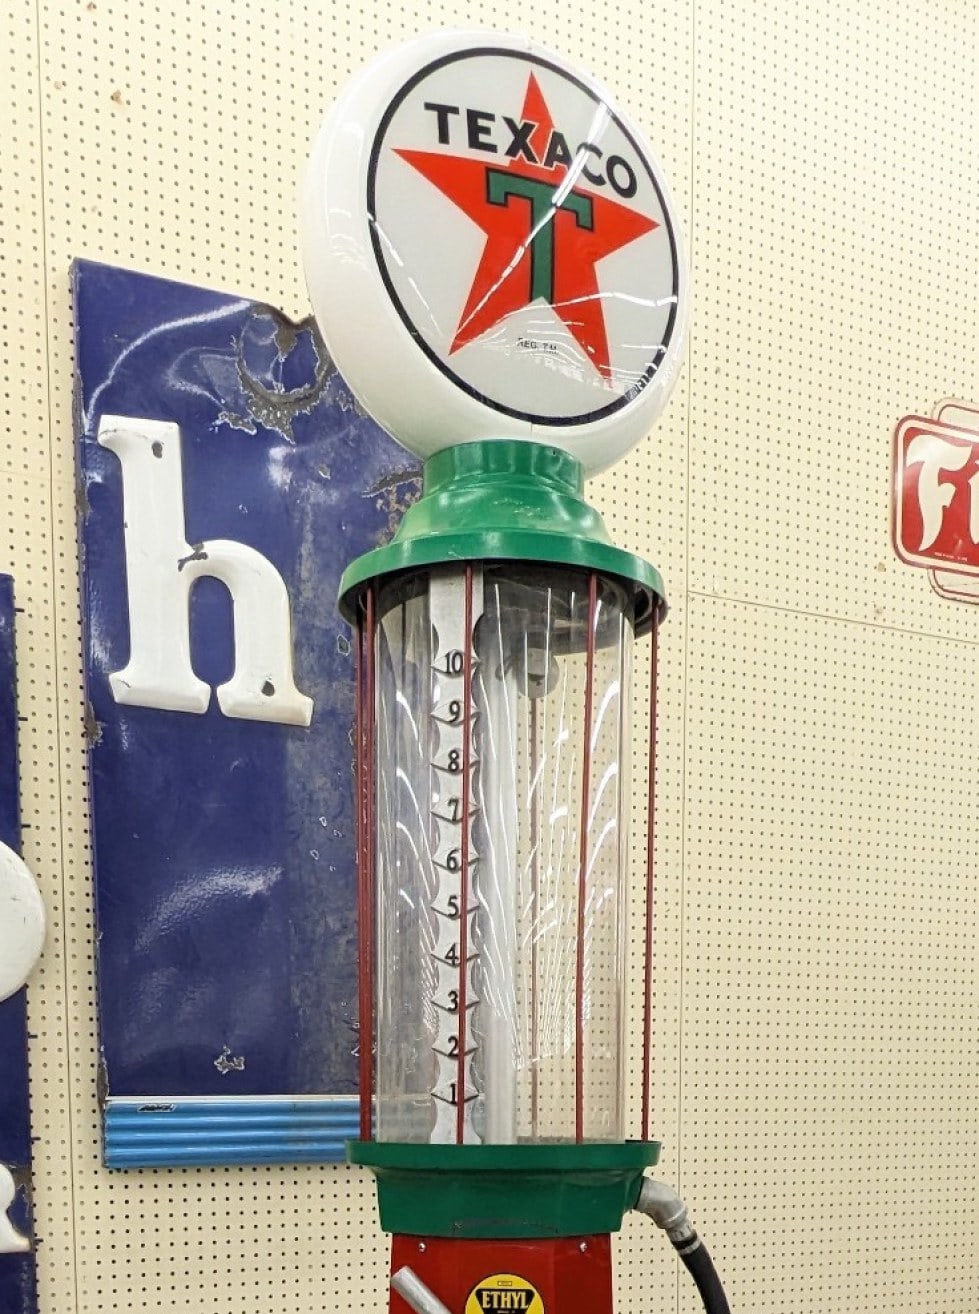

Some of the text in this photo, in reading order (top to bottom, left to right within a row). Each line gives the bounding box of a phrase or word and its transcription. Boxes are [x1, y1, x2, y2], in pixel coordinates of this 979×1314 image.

[424, 102, 637, 198] TEXACO
[485, 166, 594, 304] T
[97, 414, 314, 727] h
[445, 651, 464, 674] 10
[449, 700, 460, 722] 9
[447, 750, 459, 772] 8
[447, 799, 459, 822] 7
[446, 850, 458, 872] 6
[447, 895, 458, 918] 5
[444, 943, 458, 966] 4
[447, 990, 458, 1012] 3
[447, 1036, 458, 1057] 2
[449, 1083, 457, 1104] 1
[481, 1290, 528, 1309] ETHYL
